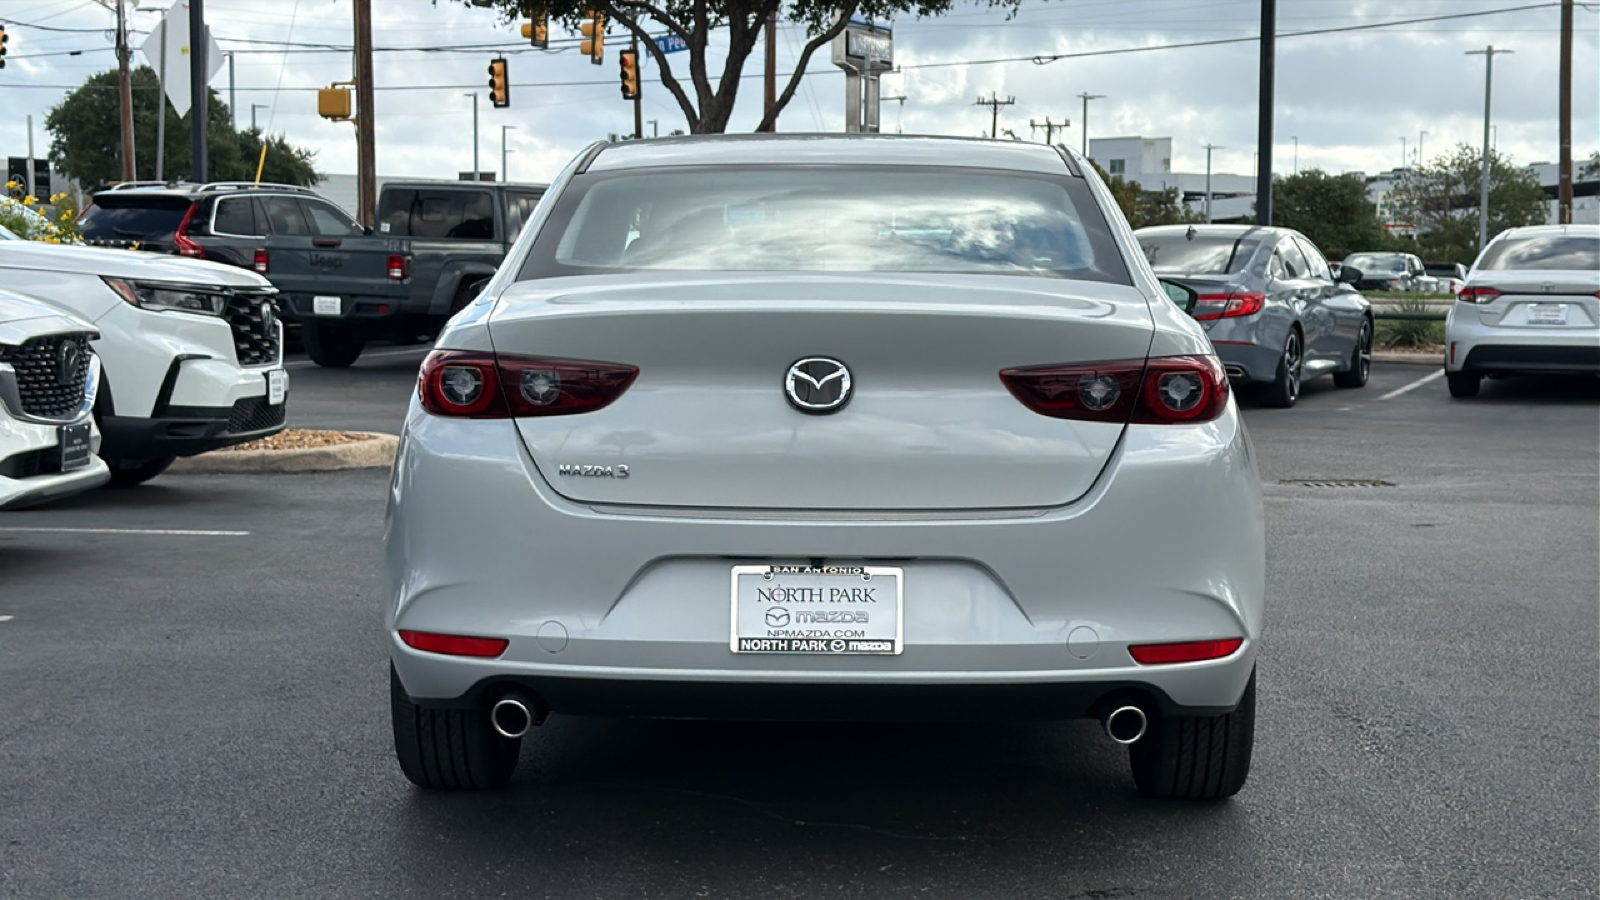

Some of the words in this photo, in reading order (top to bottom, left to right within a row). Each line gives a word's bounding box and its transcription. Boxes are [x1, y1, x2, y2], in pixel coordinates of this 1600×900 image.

[773, 566, 799, 574] SAN
[803, 566, 862, 574] ANTONIO
[757, 587, 822, 603] NORTH
[829, 587, 876, 603] PARK
[795, 610, 869, 624] mazda
[767, 629, 865, 639] NPMAZDA.COM
[741, 639, 787, 651] NORTH
[792, 639, 828, 651] PARK
[849, 641, 892, 651] mazda
